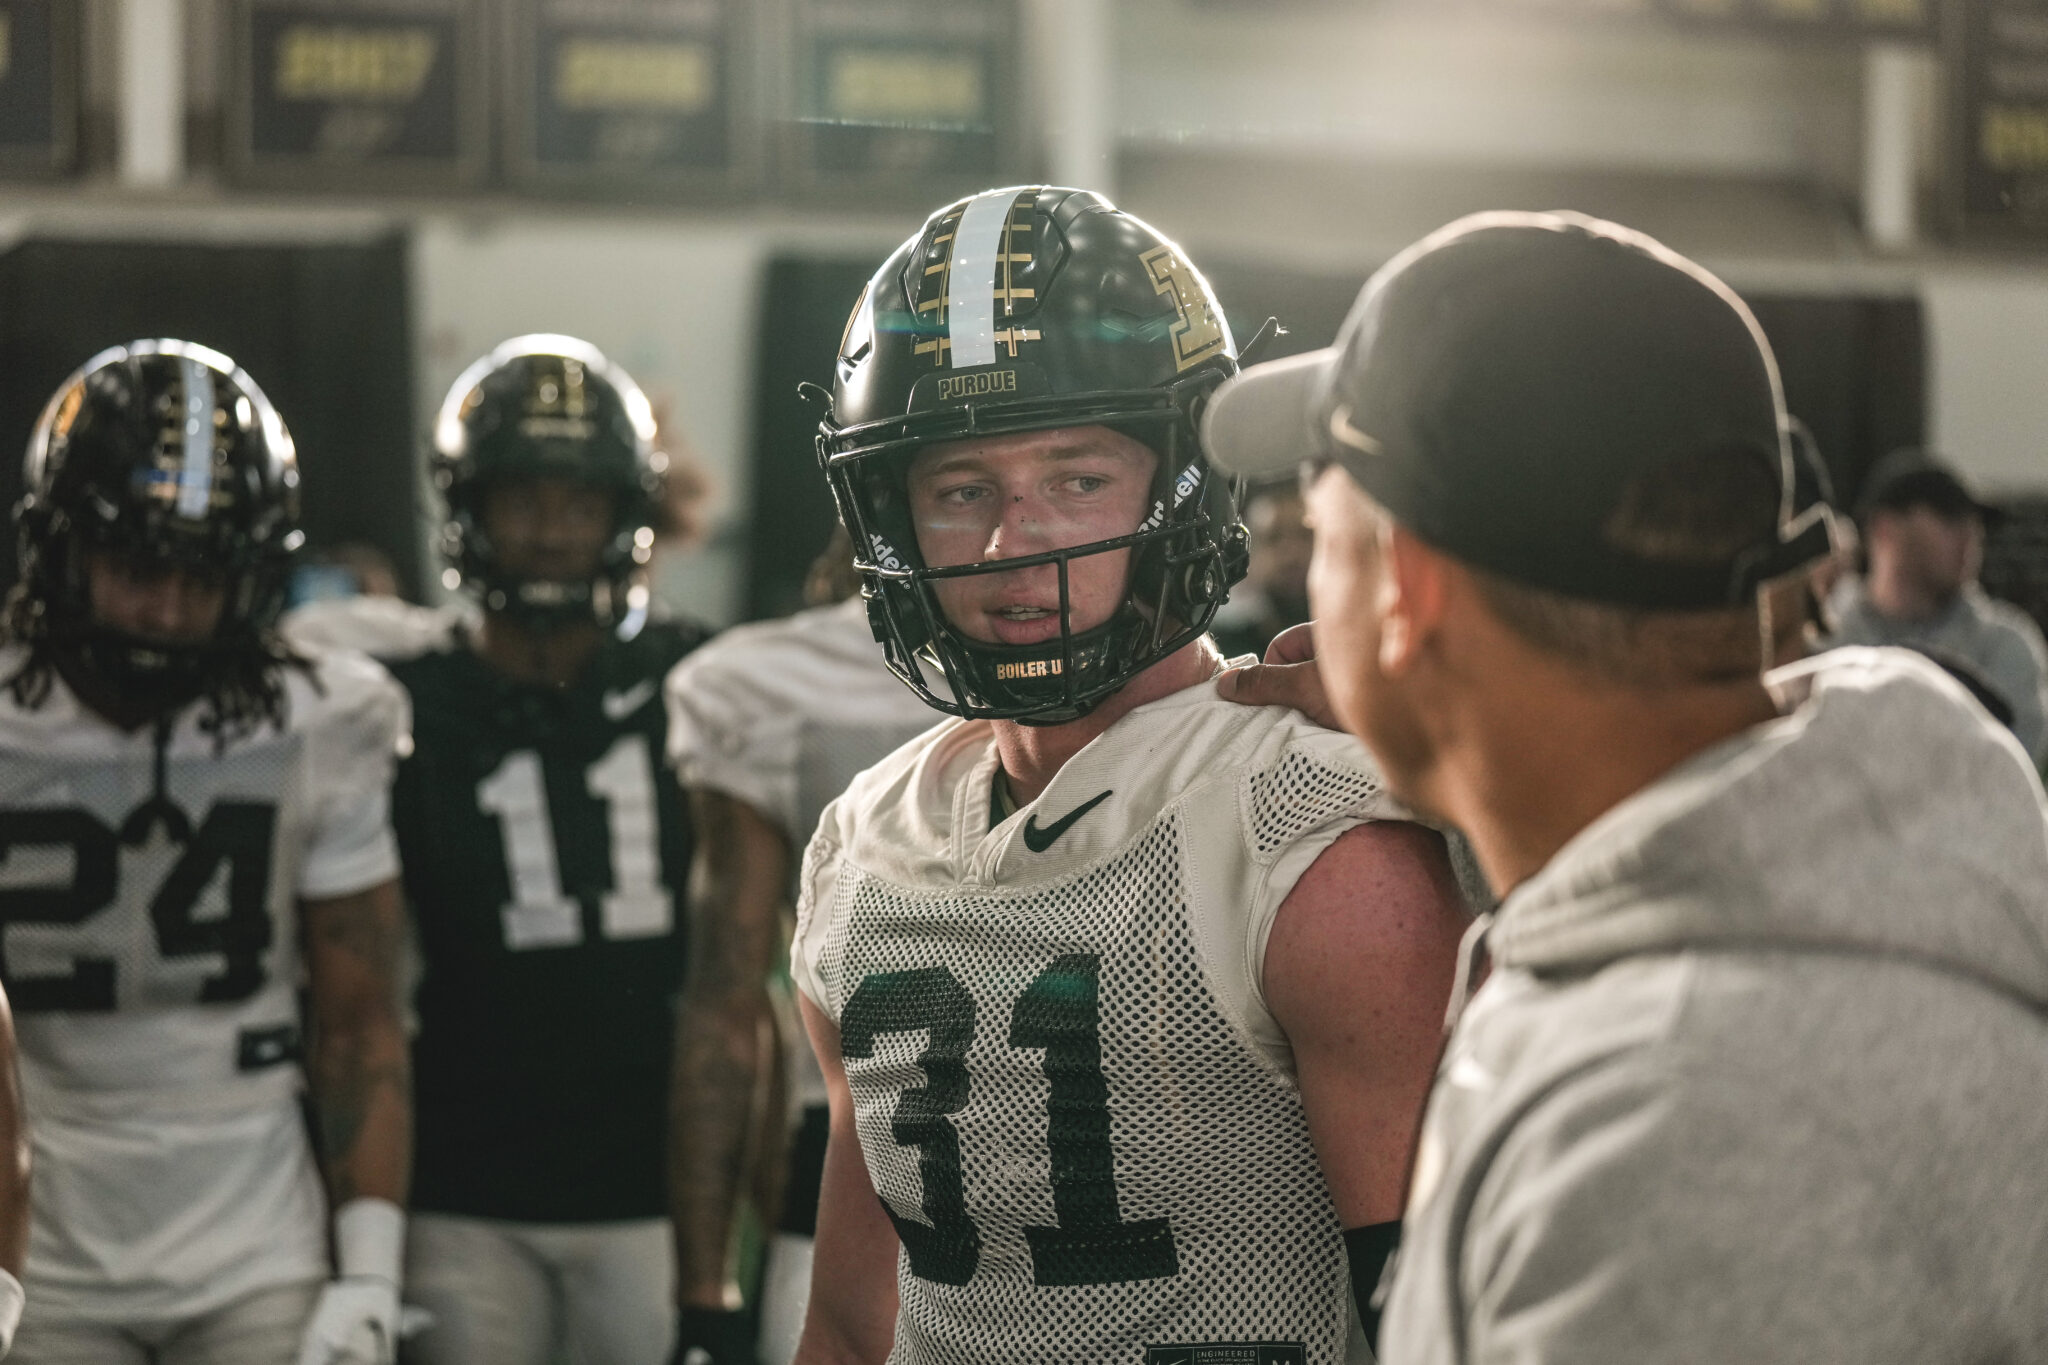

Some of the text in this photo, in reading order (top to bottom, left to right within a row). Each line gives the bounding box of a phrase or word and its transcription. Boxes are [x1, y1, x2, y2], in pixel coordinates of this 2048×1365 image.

[938, 369, 1017, 400] PURDUE
[996, 660, 1047, 680] BOILER
[476, 735, 676, 951] 11
[0, 803, 281, 1011] 24
[840, 953, 1180, 1287] 31
[1196, 1350, 1256, 1358] ENGINEERED
